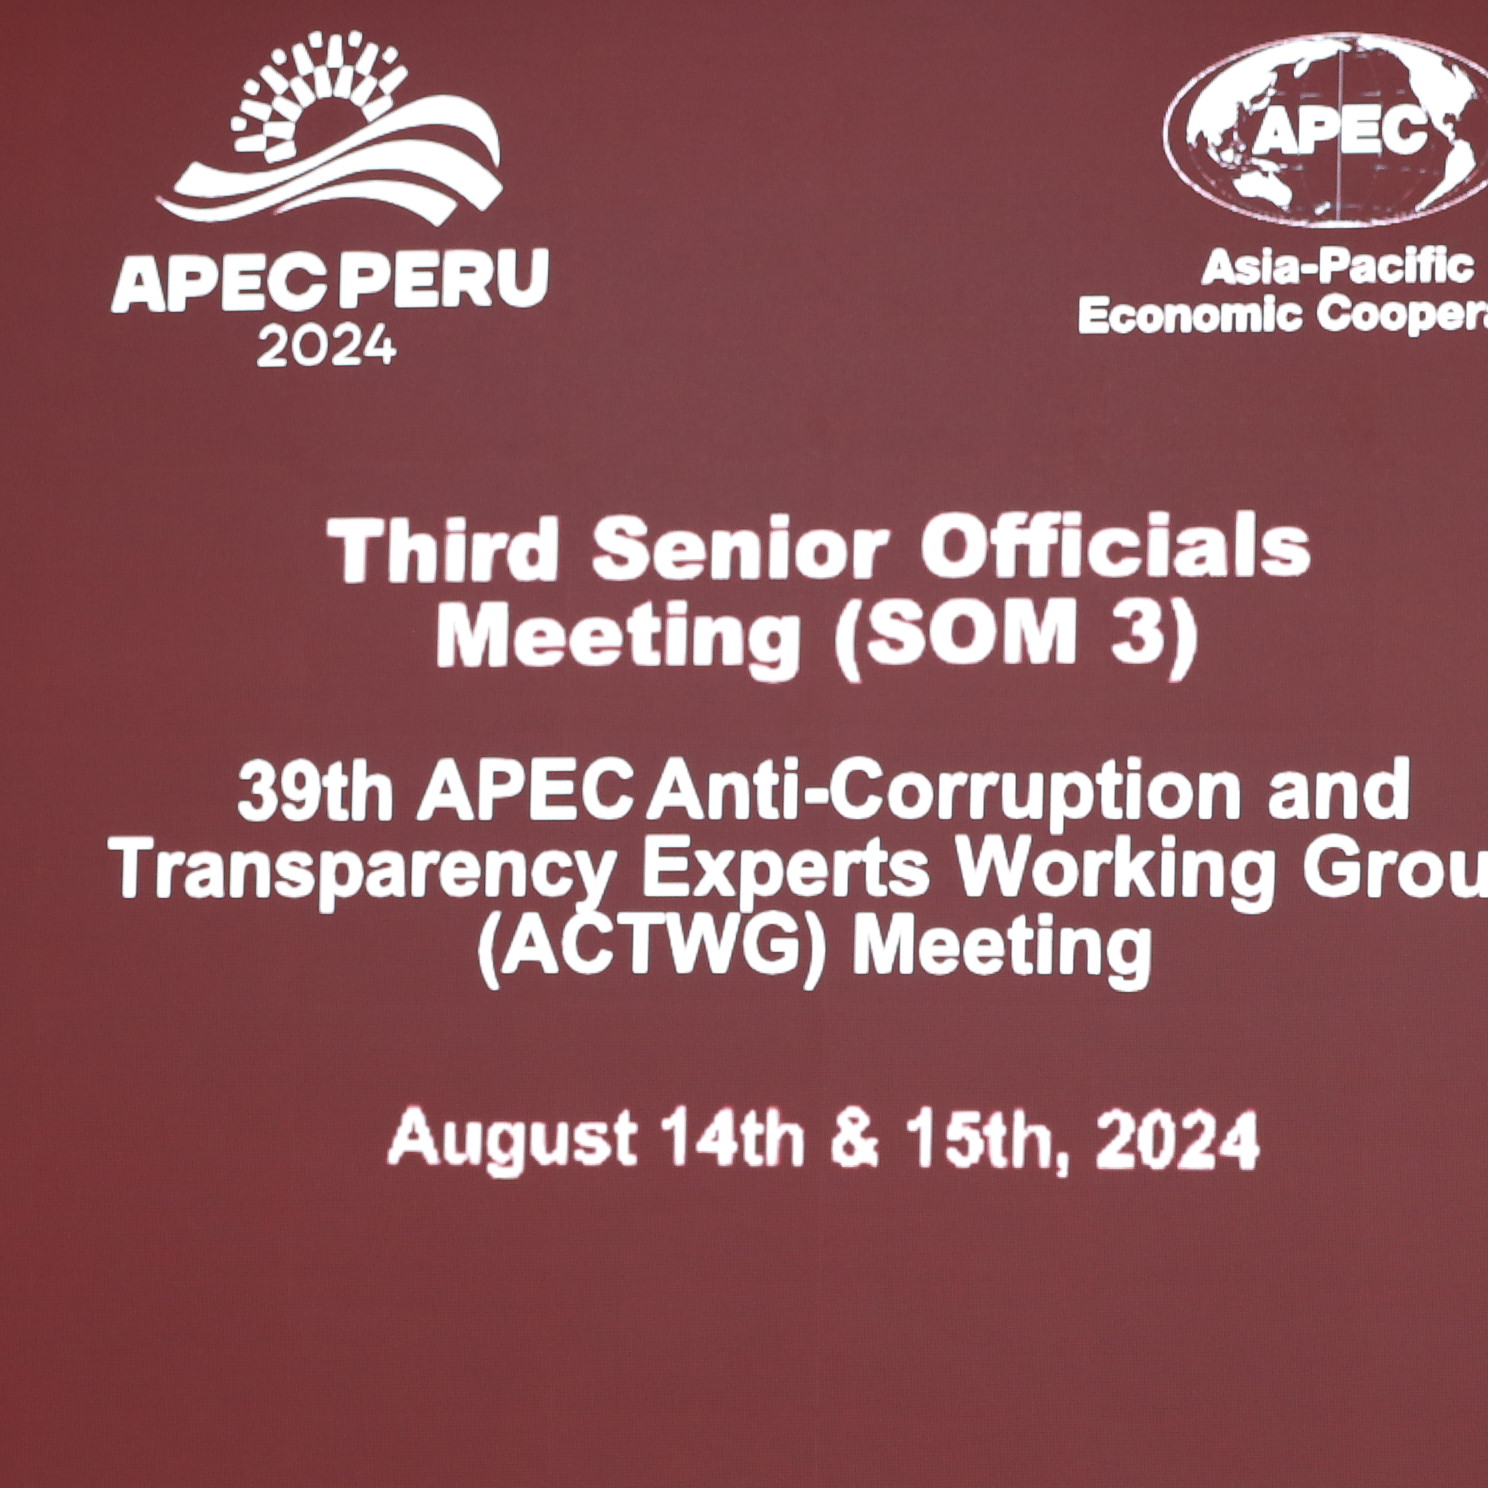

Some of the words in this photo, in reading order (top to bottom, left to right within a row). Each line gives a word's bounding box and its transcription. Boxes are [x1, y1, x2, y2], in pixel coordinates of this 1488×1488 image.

[1252, 104, 1429, 154] APEC
[111, 250, 328, 313] APEC
[339, 247, 549, 309] PERU
[1200, 244, 1475, 286] Asia-Pacific
[256, 321, 398, 368] 2024
[1078, 294, 1303, 334] Economic
[326, 515, 559, 584] Third
[592, 513, 891, 582] Senior
[921, 509, 1311, 579] Officials
[436, 599, 801, 684] Meeting
[835, 597, 1077, 684] (SOM
[1111, 596, 1198, 683] 3)
[237, 757, 393, 822] 39th
[416, 756, 634, 821] APEC
[645, 755, 1241, 834] Anti-Corruption
[1268, 755, 1410, 820] and
[107, 836, 620, 914] Transparency
[643, 833, 930, 912] Experts
[954, 830, 1276, 910] Working
[477, 914, 826, 992] (ACTWG)
[853, 912, 1152, 993] Meeting
[387, 1105, 639, 1179] August
[661, 1104, 805, 1167] 14th
[831, 1105, 879, 1168] &
[906, 1105, 1070, 1178] 15th,
[1096, 1107, 1261, 1171] 2024
